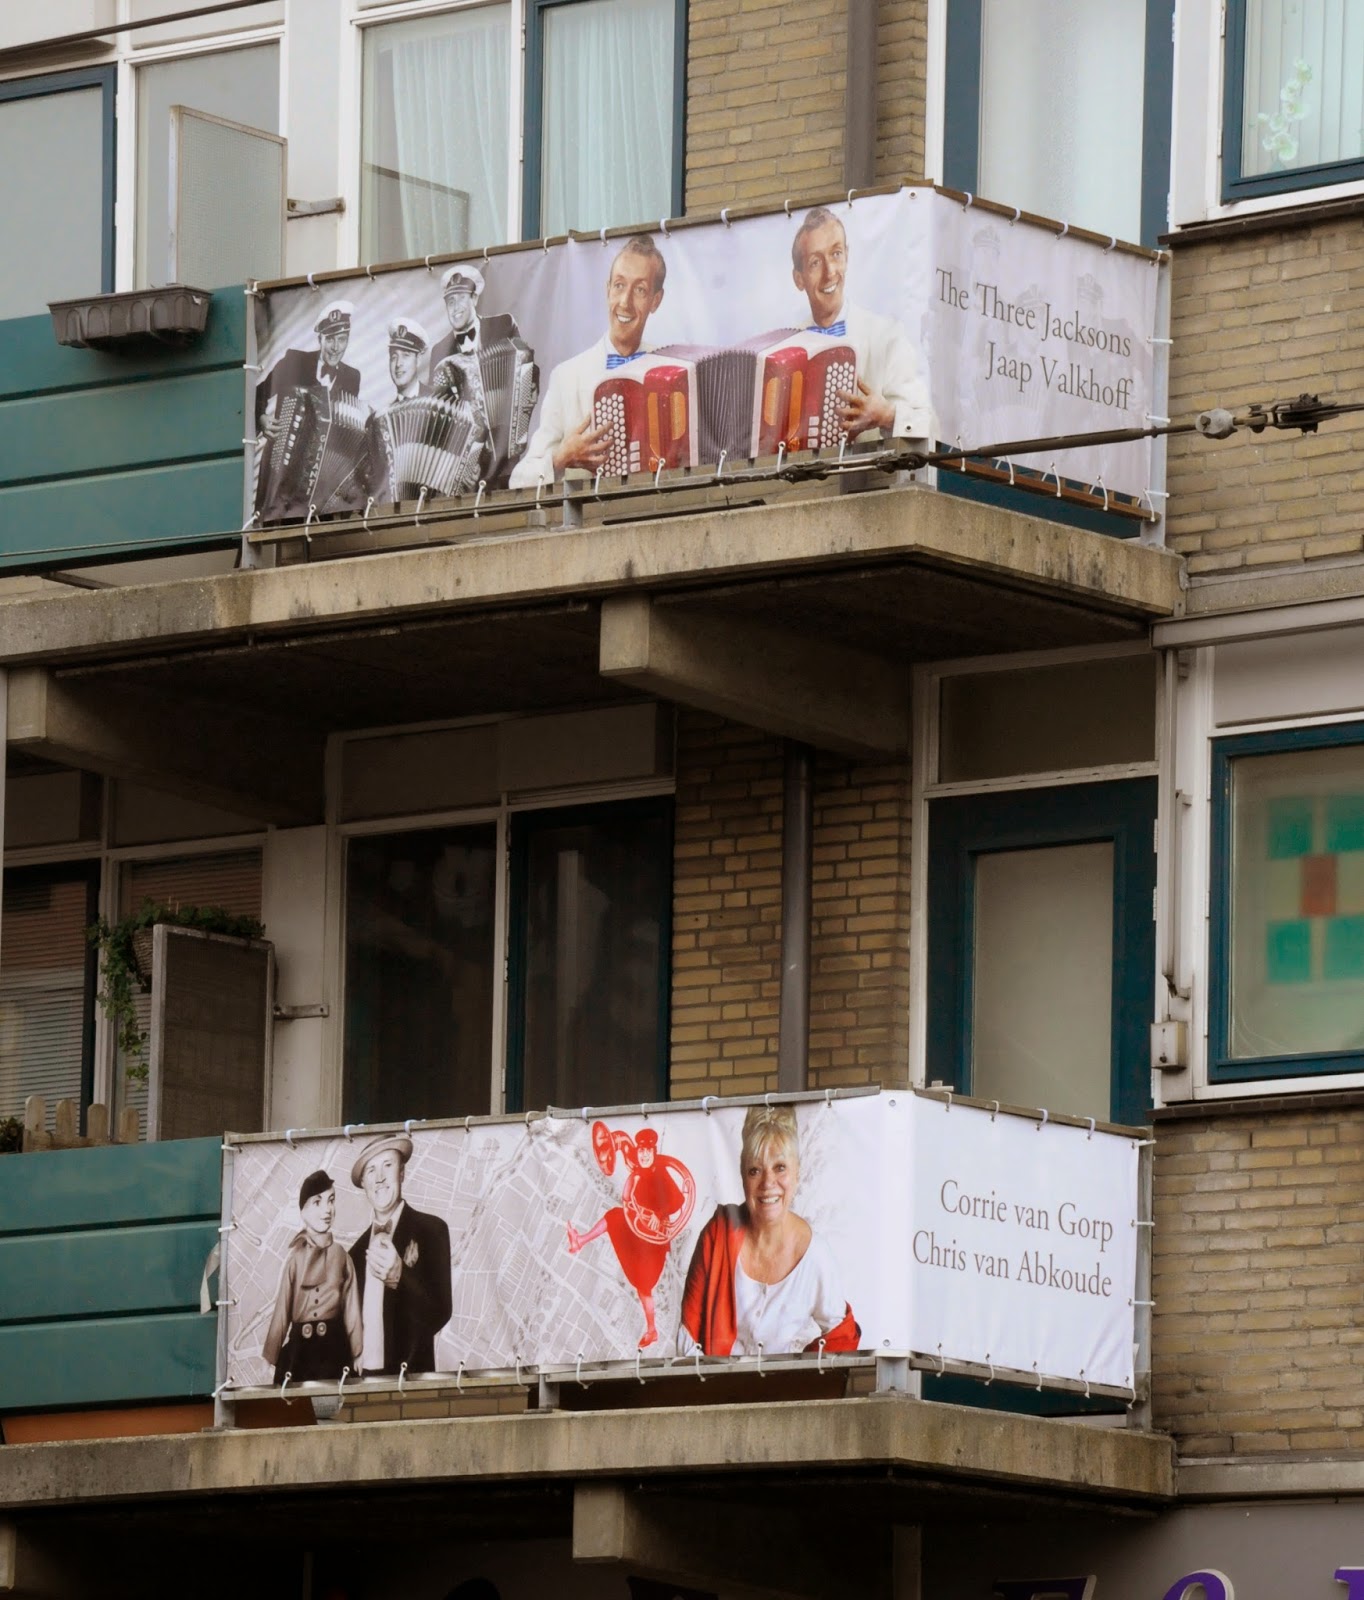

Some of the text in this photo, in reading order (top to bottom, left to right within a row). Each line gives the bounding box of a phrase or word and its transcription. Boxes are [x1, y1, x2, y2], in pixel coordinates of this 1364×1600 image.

[936, 268, 1131, 357] The Three Jacksons
[985, 341, 1134, 410] Jaap Valkhoff
[940, 1179, 1113, 1252] Corrie van Gorp
[912, 1230, 1112, 1297] Chris van Abkoude
